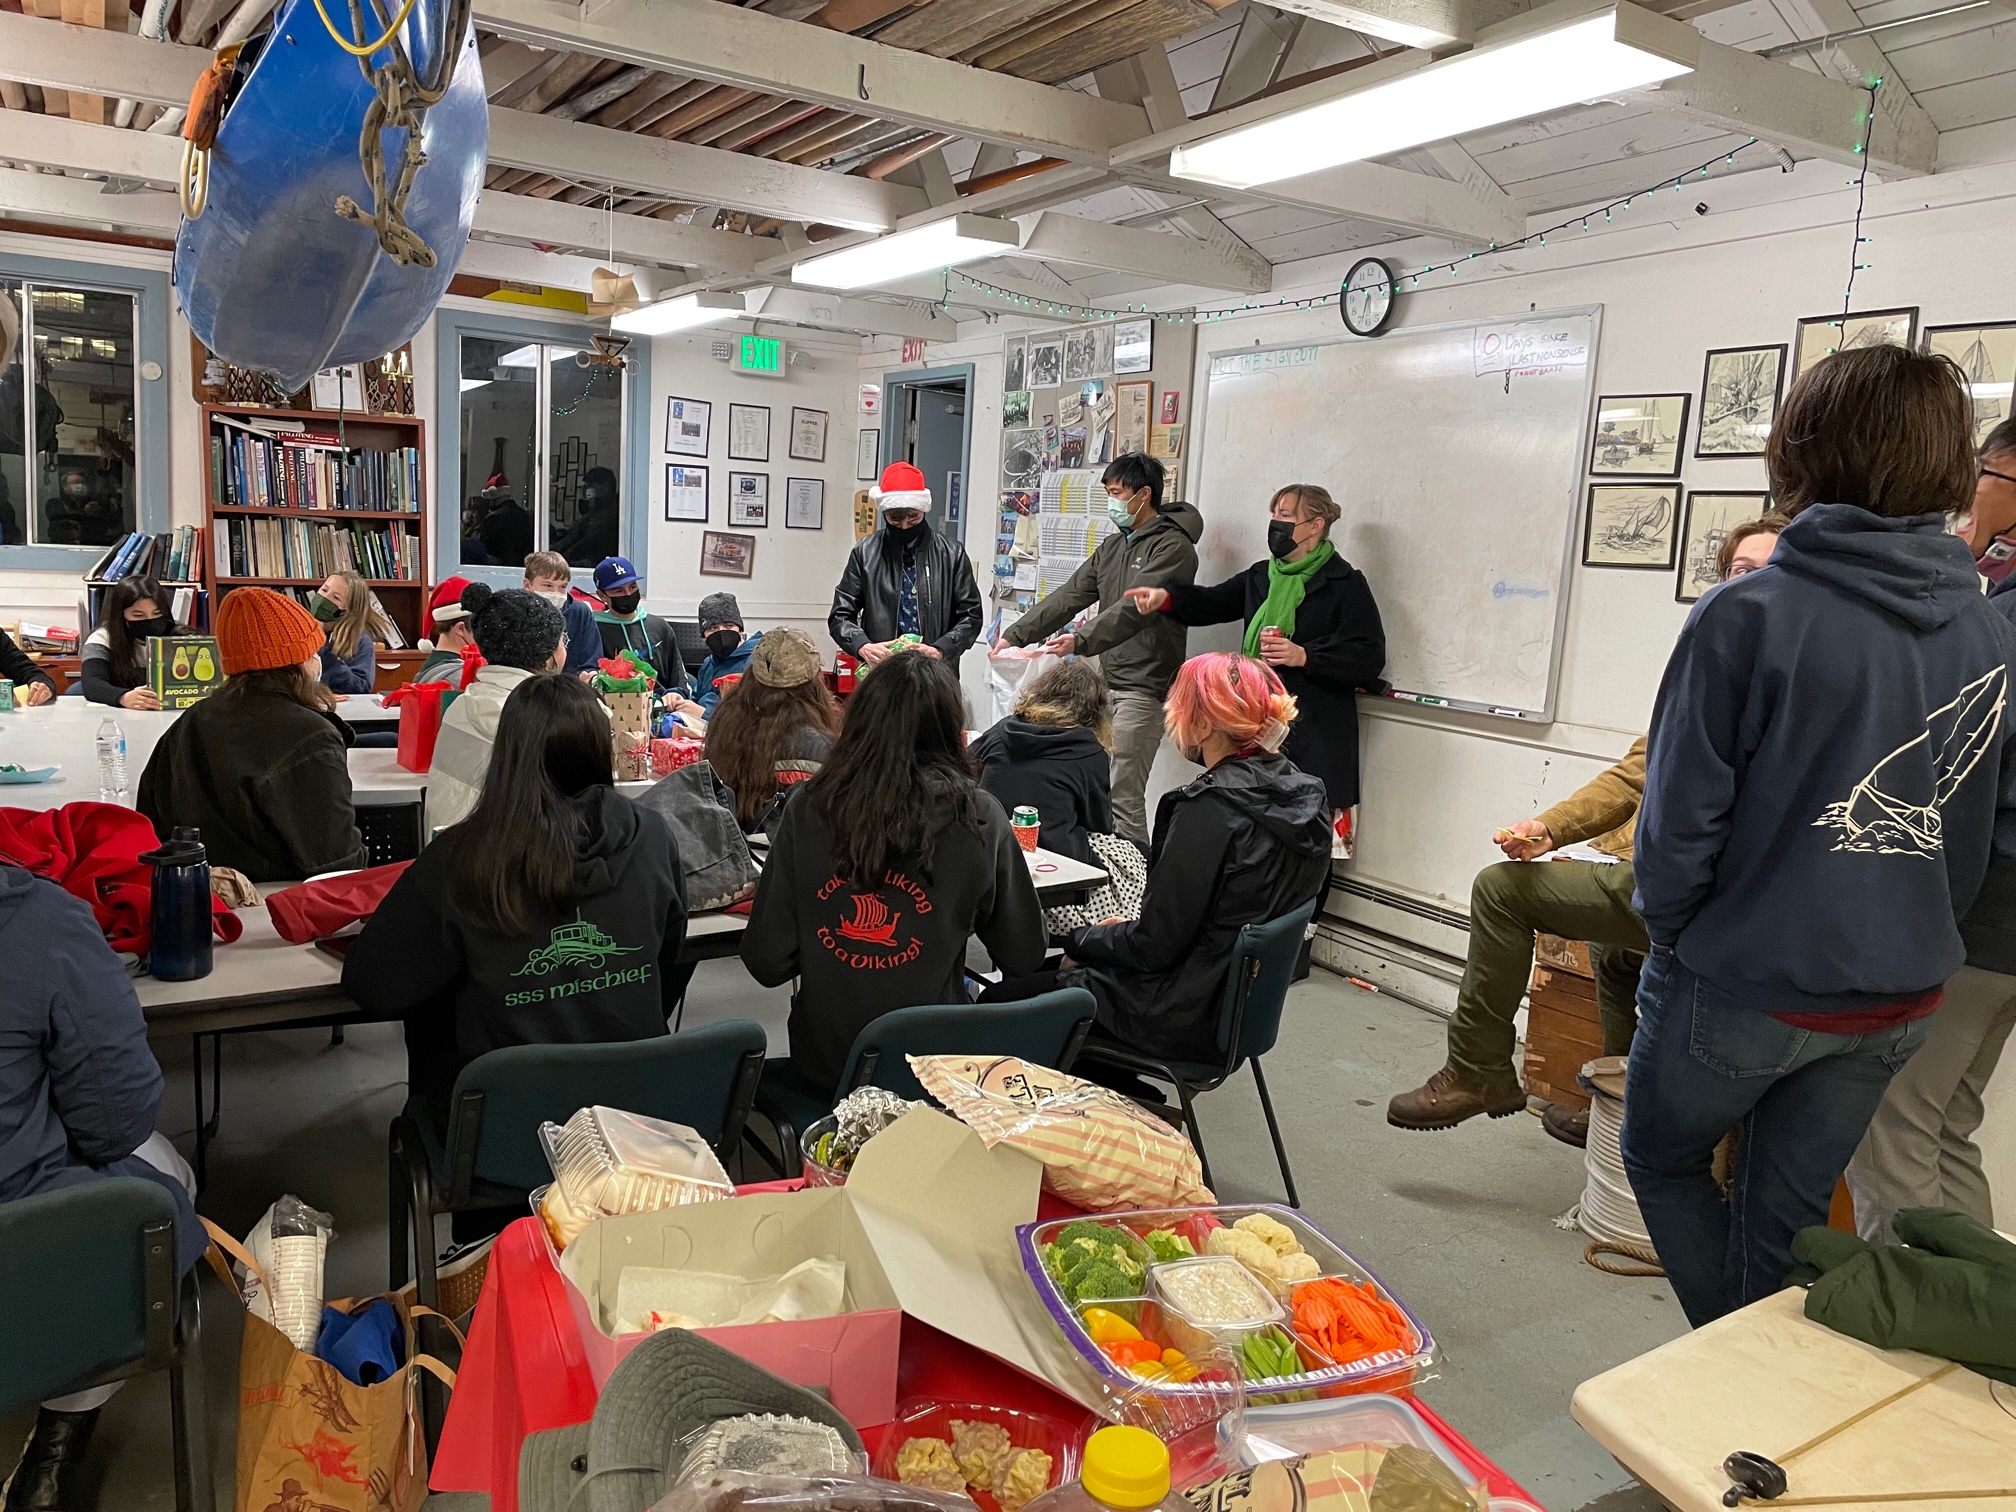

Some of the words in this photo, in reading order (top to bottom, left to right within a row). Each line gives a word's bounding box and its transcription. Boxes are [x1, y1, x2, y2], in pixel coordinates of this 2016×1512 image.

[1367, 268, 1374, 276] 12
[1349, 295, 1355, 303] 9
[1351, 307, 1357, 315] 8
[1365, 318, 1371, 327] 6
[1374, 314, 1379, 322] 5
[742, 336, 780, 371] EXIT
[902, 338, 925, 363] EXIT
[1213, 357, 1234, 373] PUT
[1239, 354, 1262, 371] THE
[1265, 350, 1291, 367] SIGN
[1511, 352, 1537, 366] LAST
[1524, 369, 1538, 377] NOT
[281, 431, 314, 439] PILOTING
[278, 450, 286, 481] PILOTING
[612, 563, 626, 575] LA
[817, 874, 850, 900] tak
[504, 989, 544, 1007] sss
[550, 964, 652, 1000] mischief
